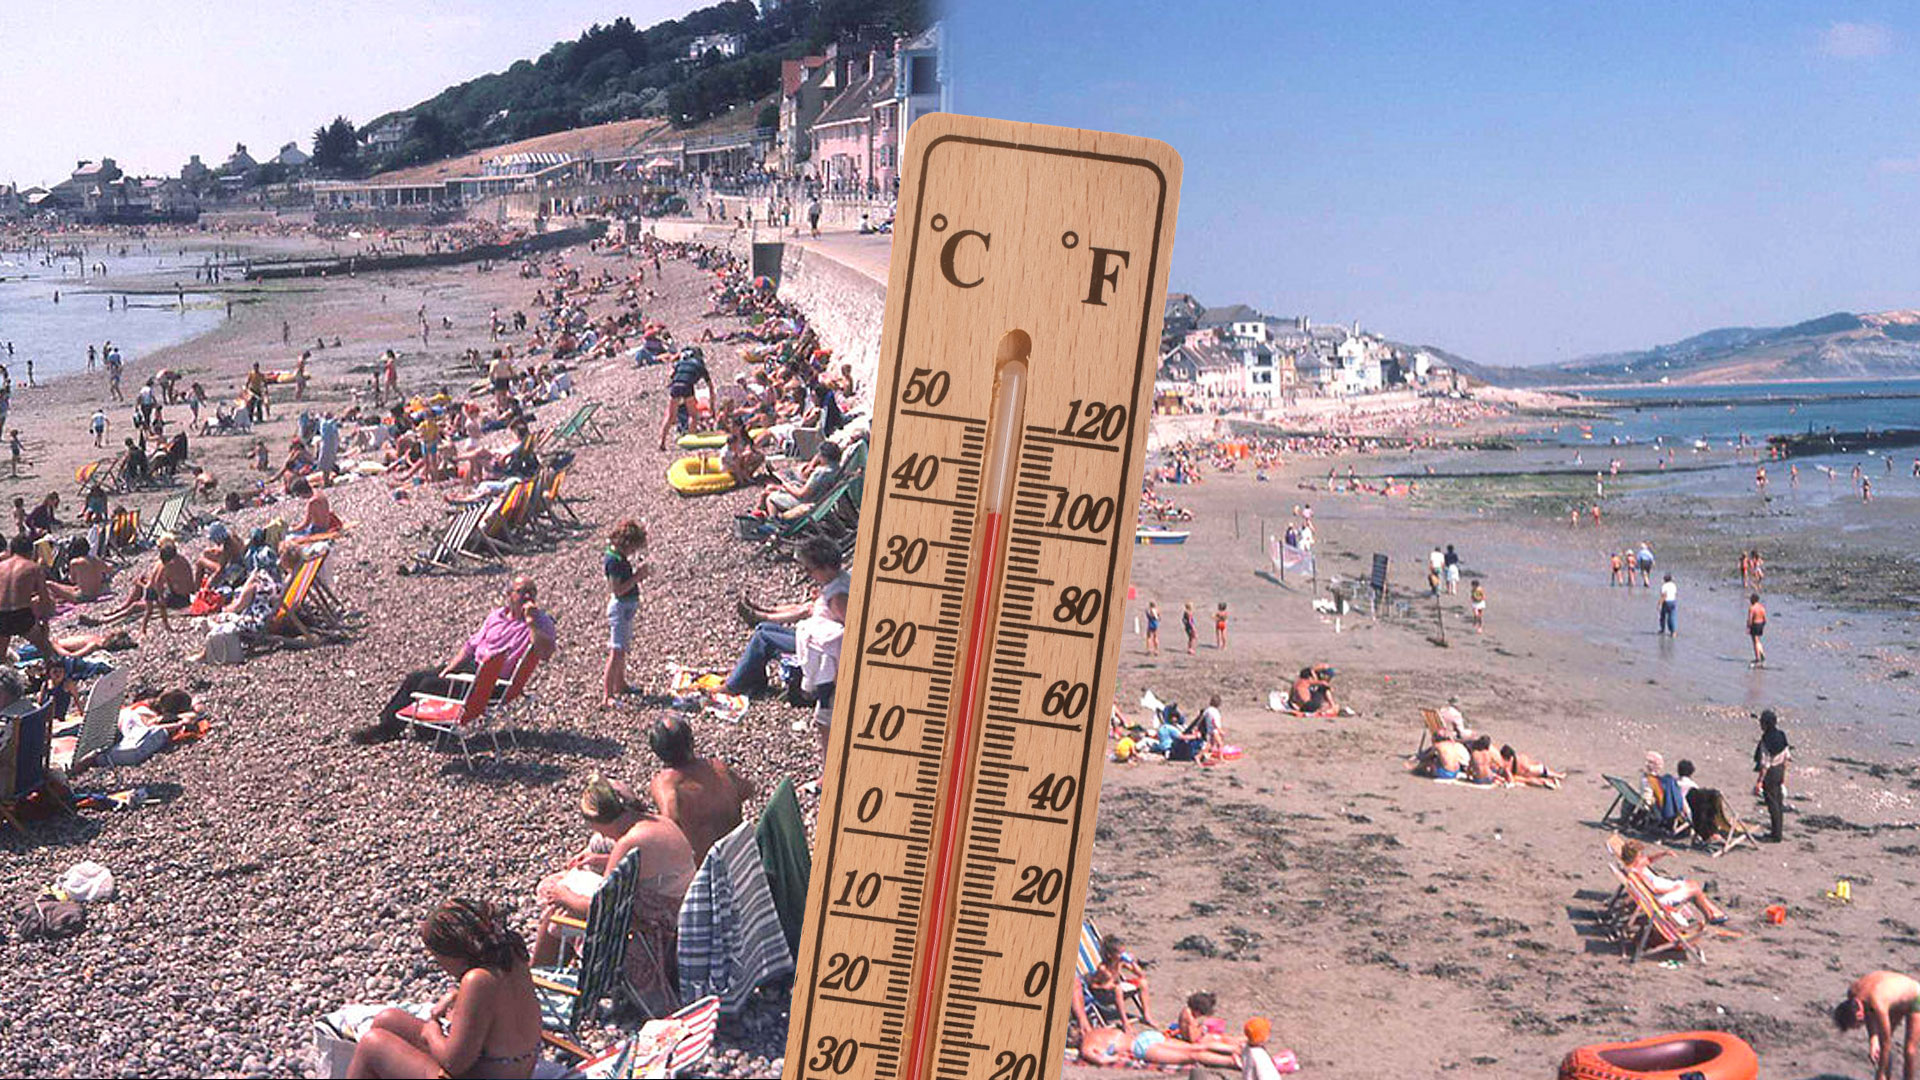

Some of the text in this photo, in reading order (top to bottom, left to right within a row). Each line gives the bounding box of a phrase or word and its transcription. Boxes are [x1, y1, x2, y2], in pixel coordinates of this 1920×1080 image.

[902, 368, 951, 406] 50
[1058, 400, 1126, 441] 120
[891, 453, 939, 491] 40
[1045, 491, 1115, 534] 100
[878, 535, 928, 573] 30
[1053, 586, 1101, 625] 80
[866, 618, 917, 657] 20
[1041, 680, 1089, 719] 60
[857, 703, 905, 741] 10
[856, 787, 883, 823] 0
[1029, 775, 1076, 812] 40
[833, 870, 882, 908] 10
[1012, 866, 1064, 905] 20
[819, 953, 870, 992] 20
[1023, 962, 1050, 998] 0
[809, 1036, 858, 1074] 30
[988, 1050, 1037, 1080] 20
